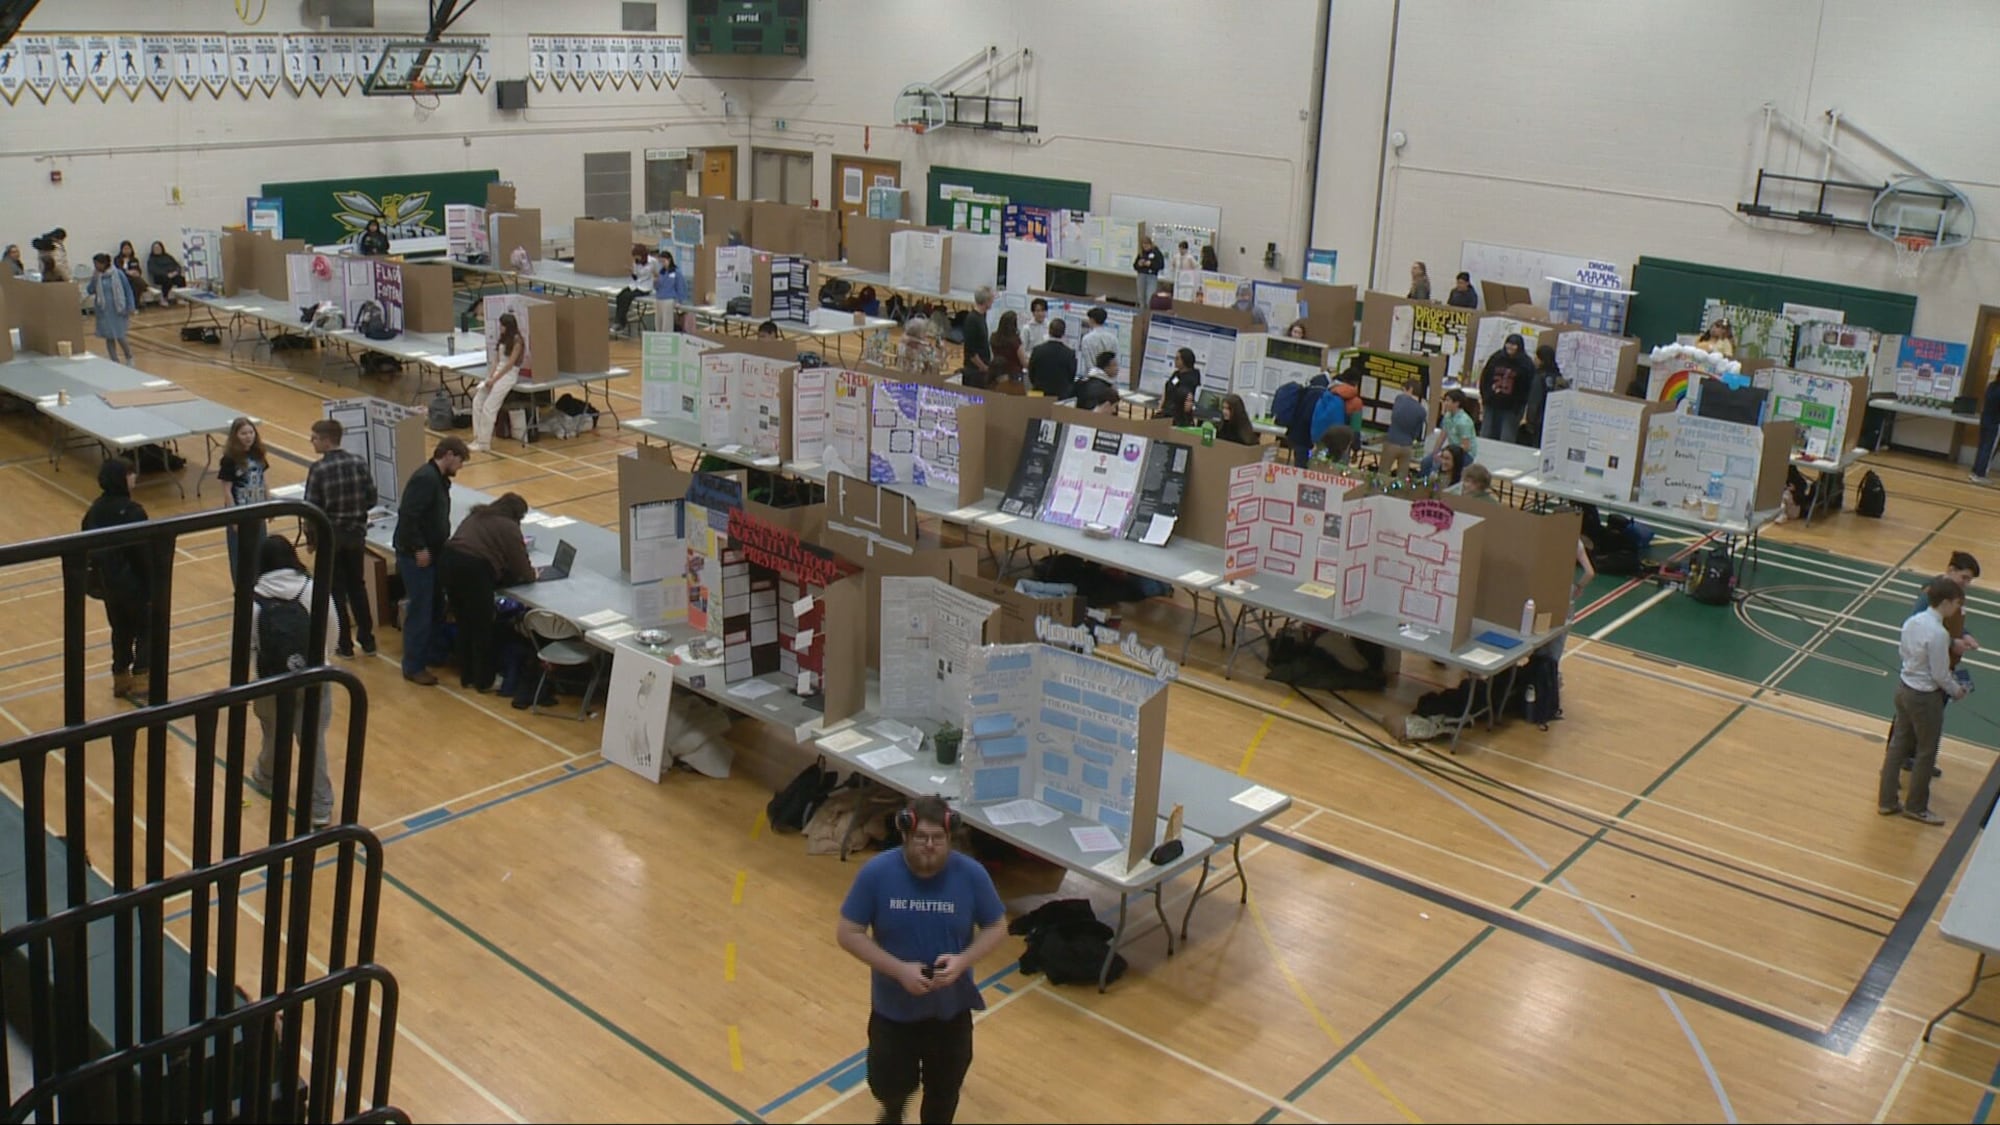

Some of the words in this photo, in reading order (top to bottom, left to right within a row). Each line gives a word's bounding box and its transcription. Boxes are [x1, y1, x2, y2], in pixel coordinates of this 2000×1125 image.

[1268, 463, 1299, 477] SPICY
[1302, 470, 1357, 488] SOLUTION
[909, 900, 955, 913] POLYTECH
